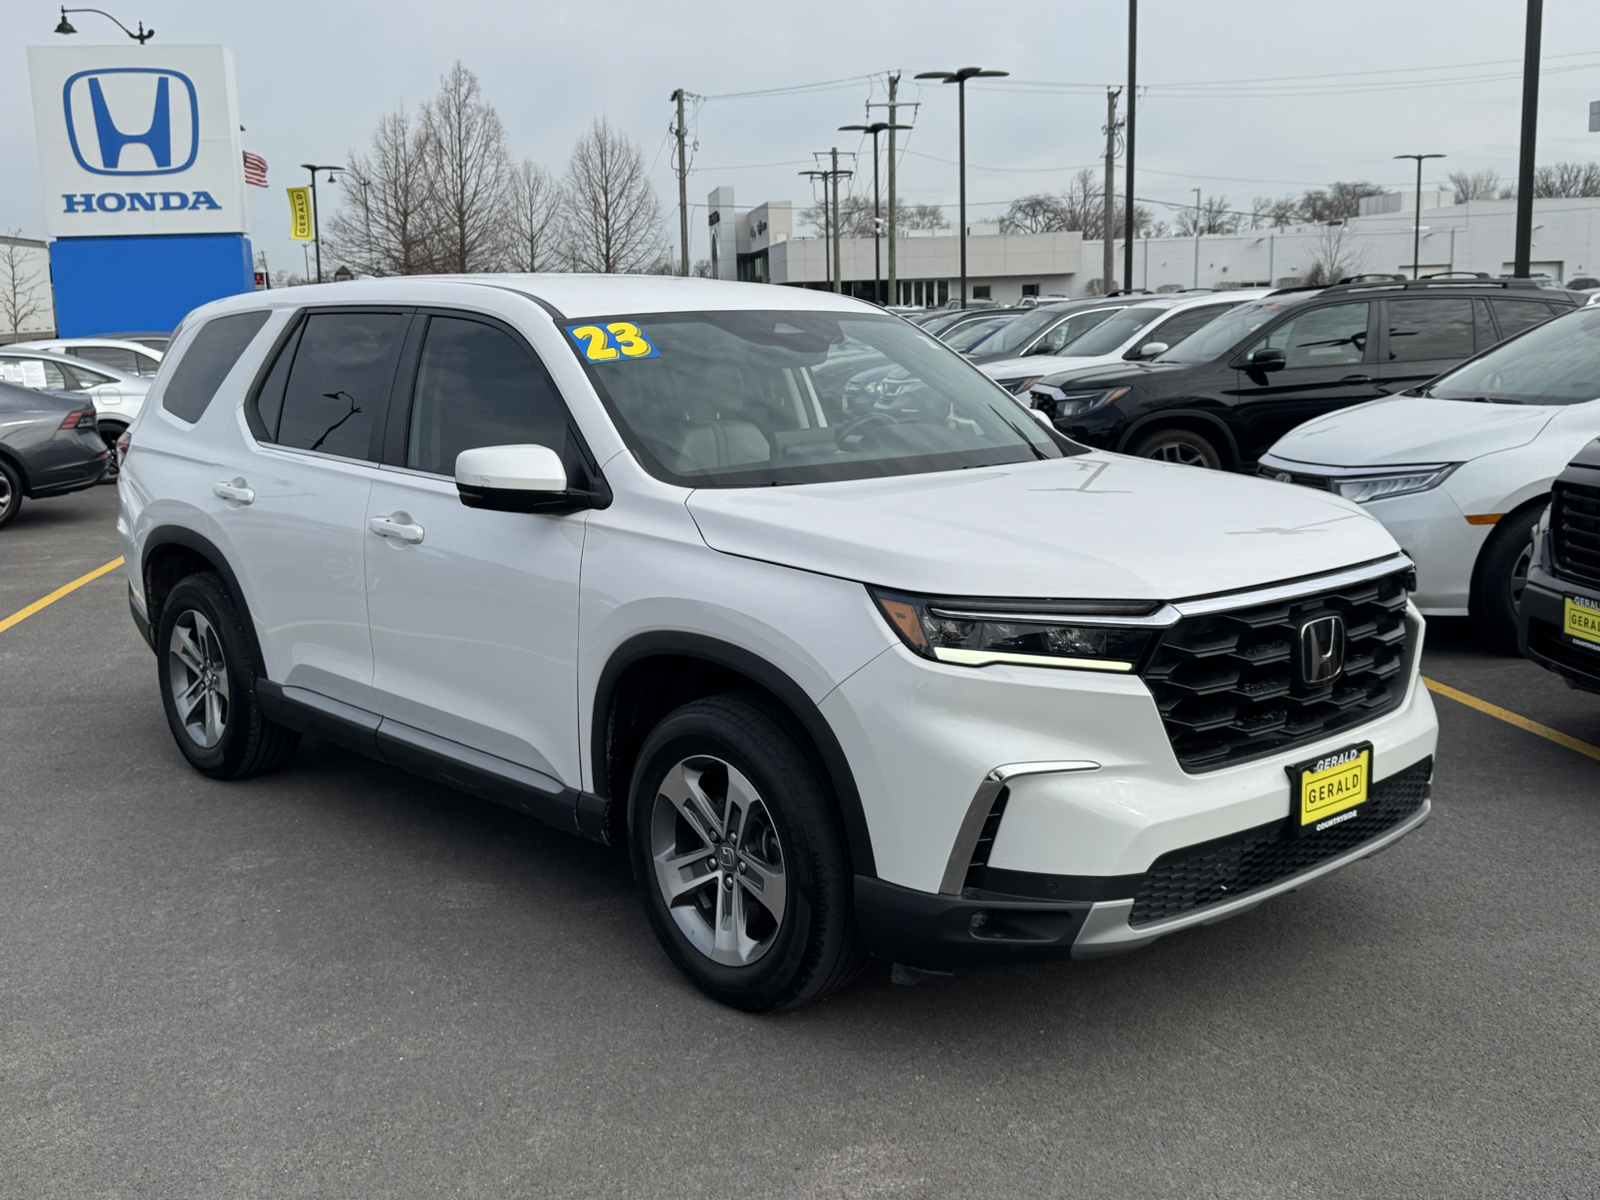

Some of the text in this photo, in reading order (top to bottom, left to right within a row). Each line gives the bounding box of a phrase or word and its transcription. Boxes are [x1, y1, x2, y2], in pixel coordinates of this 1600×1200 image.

[62, 191, 222, 213] HONDA
[296, 194, 306, 233] GERALD
[573, 322, 652, 360] 23
[1316, 749, 1358, 772] GERALD
[1309, 774, 1359, 804] GERALD
[1316, 810, 1358, 831] COUNTRYSIDE
